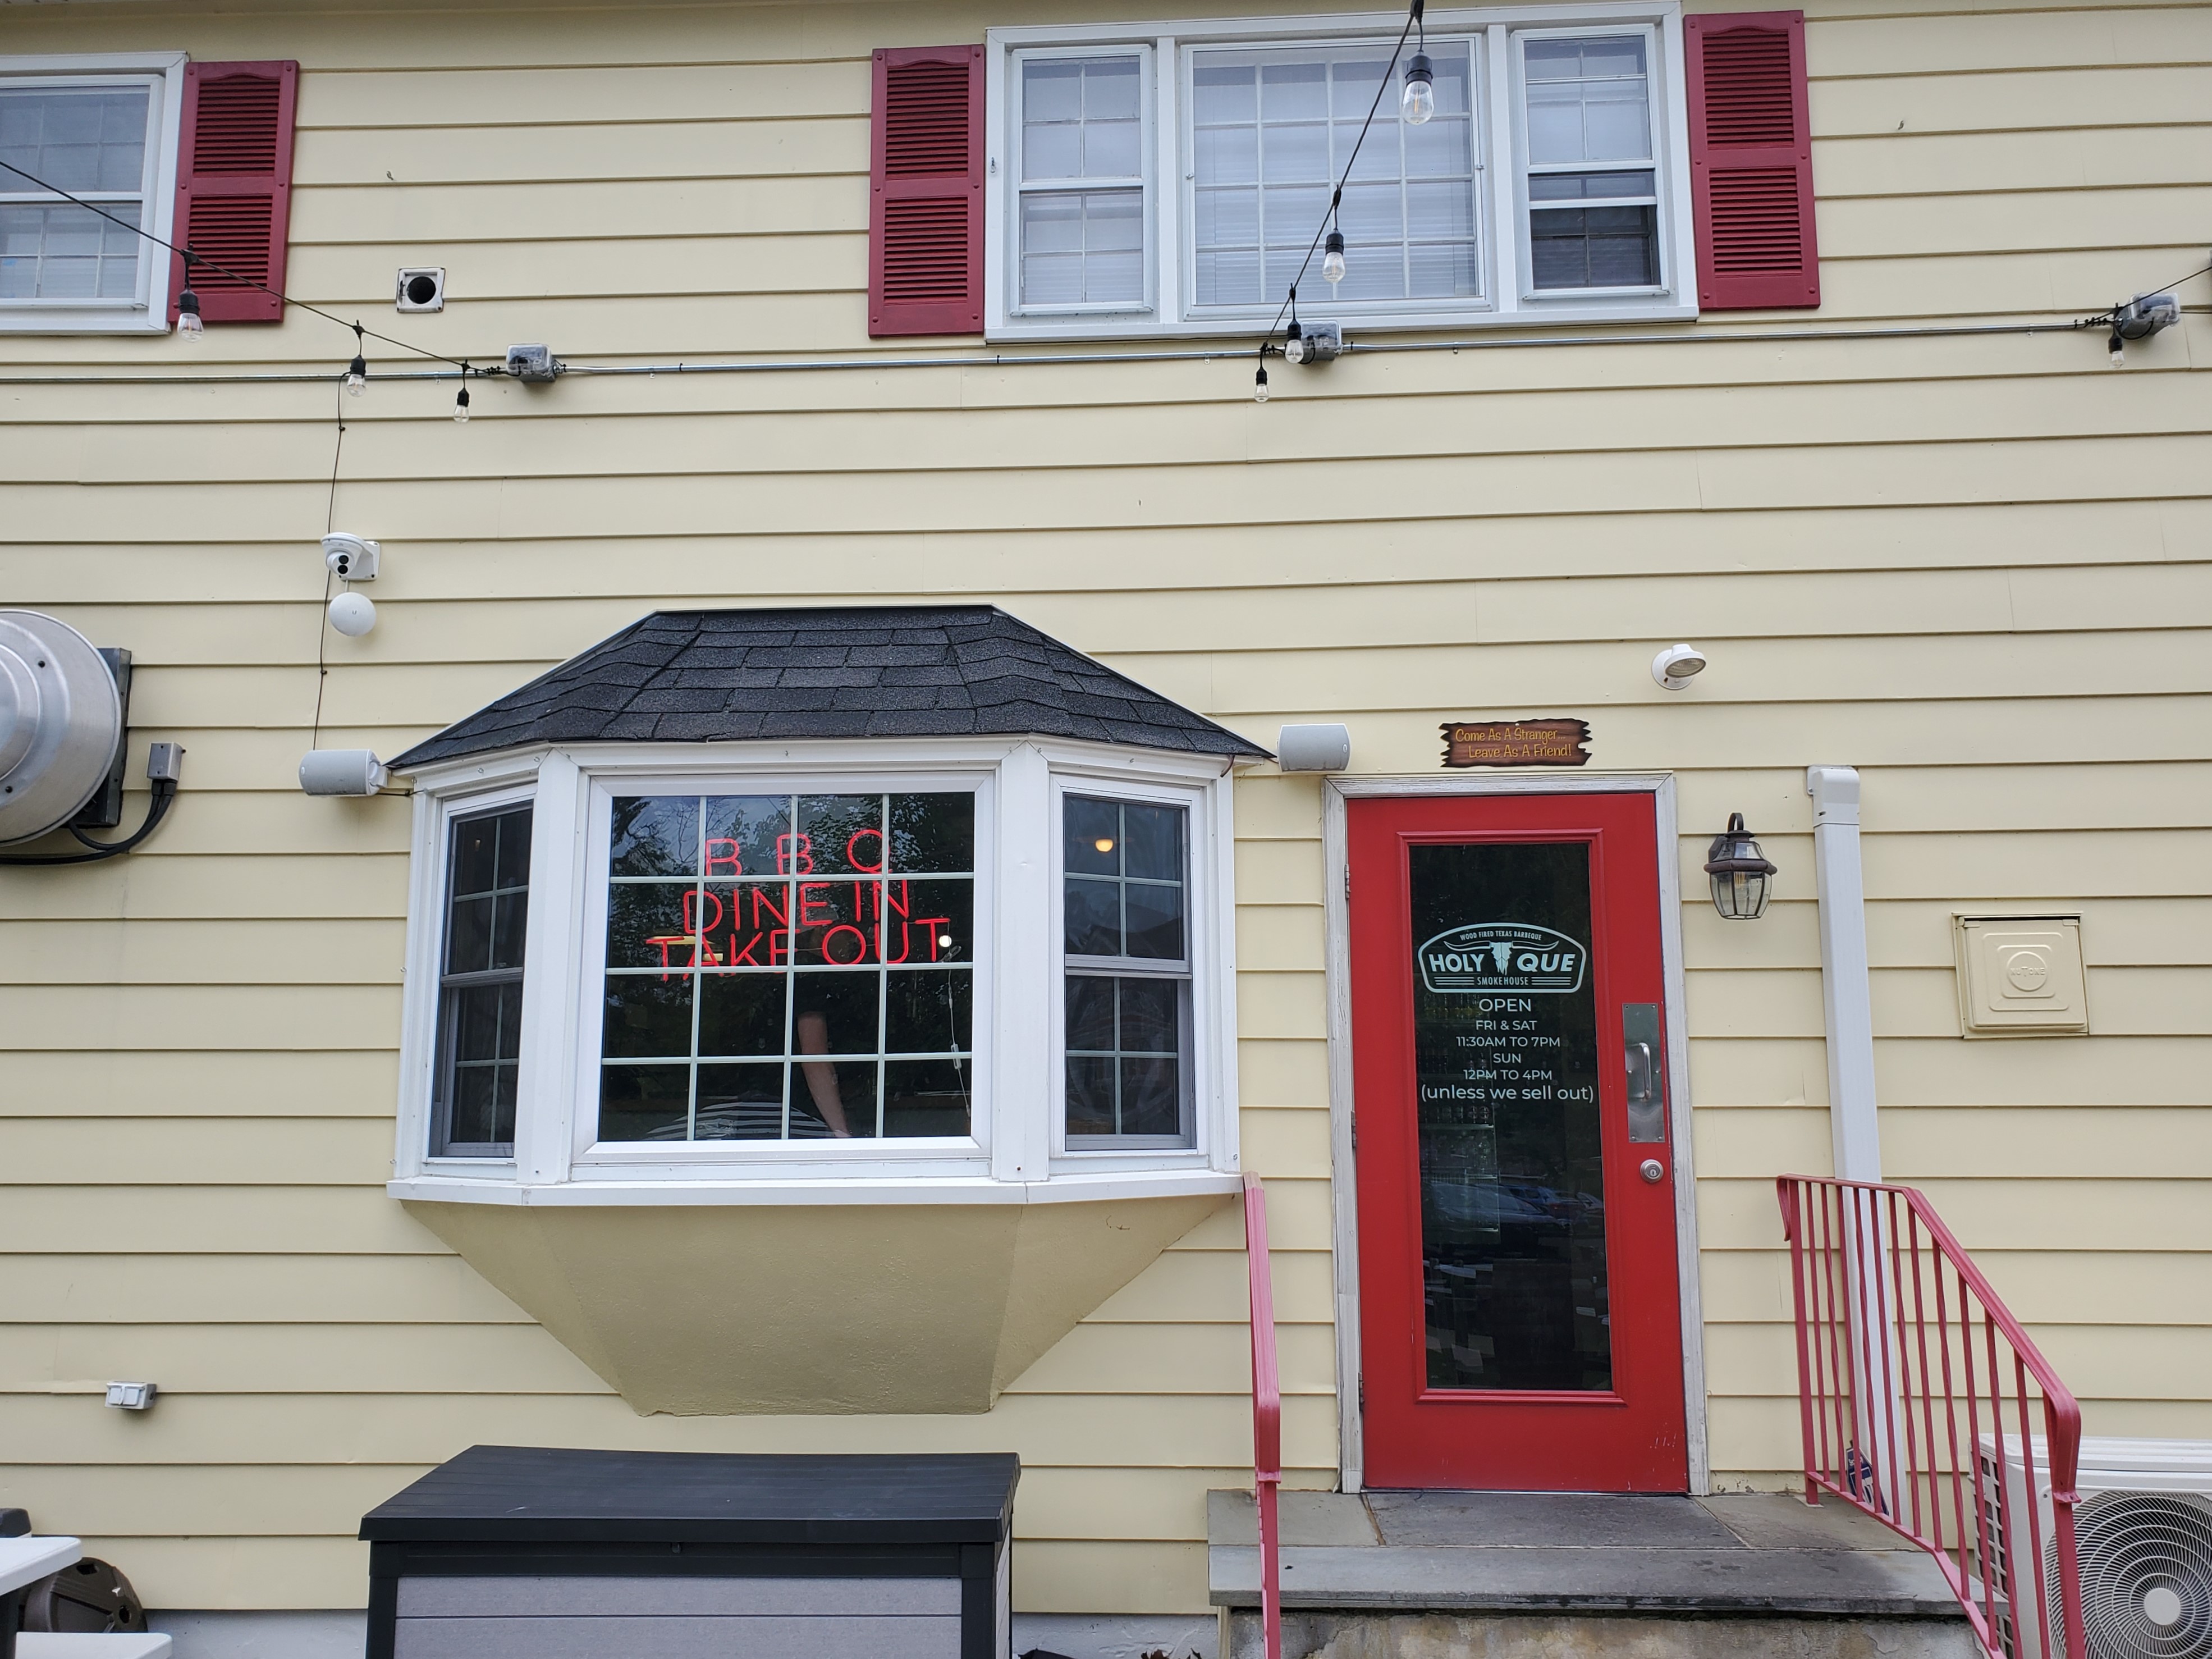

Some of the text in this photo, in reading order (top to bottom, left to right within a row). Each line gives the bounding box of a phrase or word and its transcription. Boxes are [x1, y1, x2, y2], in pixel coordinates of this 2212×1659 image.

[1455, 727, 1566, 744] Come As A Stranger...
[1468, 743, 1572, 758] Leave As A Friend!
[683, 879, 909, 934] DINE IN
[822, 917, 951, 966] OUT
[1459, 932, 1477, 941] WOOD
[1514, 931, 1542, 941] BARBEQUE
[1428, 953, 1576, 972] HOLY QUE
[1477, 976, 1529, 986] SMOKEHOUSE
[1478, 998, 1532, 1012] OPEN
[1475, 1020, 1538, 1031] FRI & SAT
[1456, 1036, 1560, 1047] 11:30AM TO 7PM
[1492, 1053, 1522, 1064] SUN
[1463, 1069, 1552, 1080] 12PM TO 4PM
[1421, 1084, 1594, 1103] (unless we sell out)
